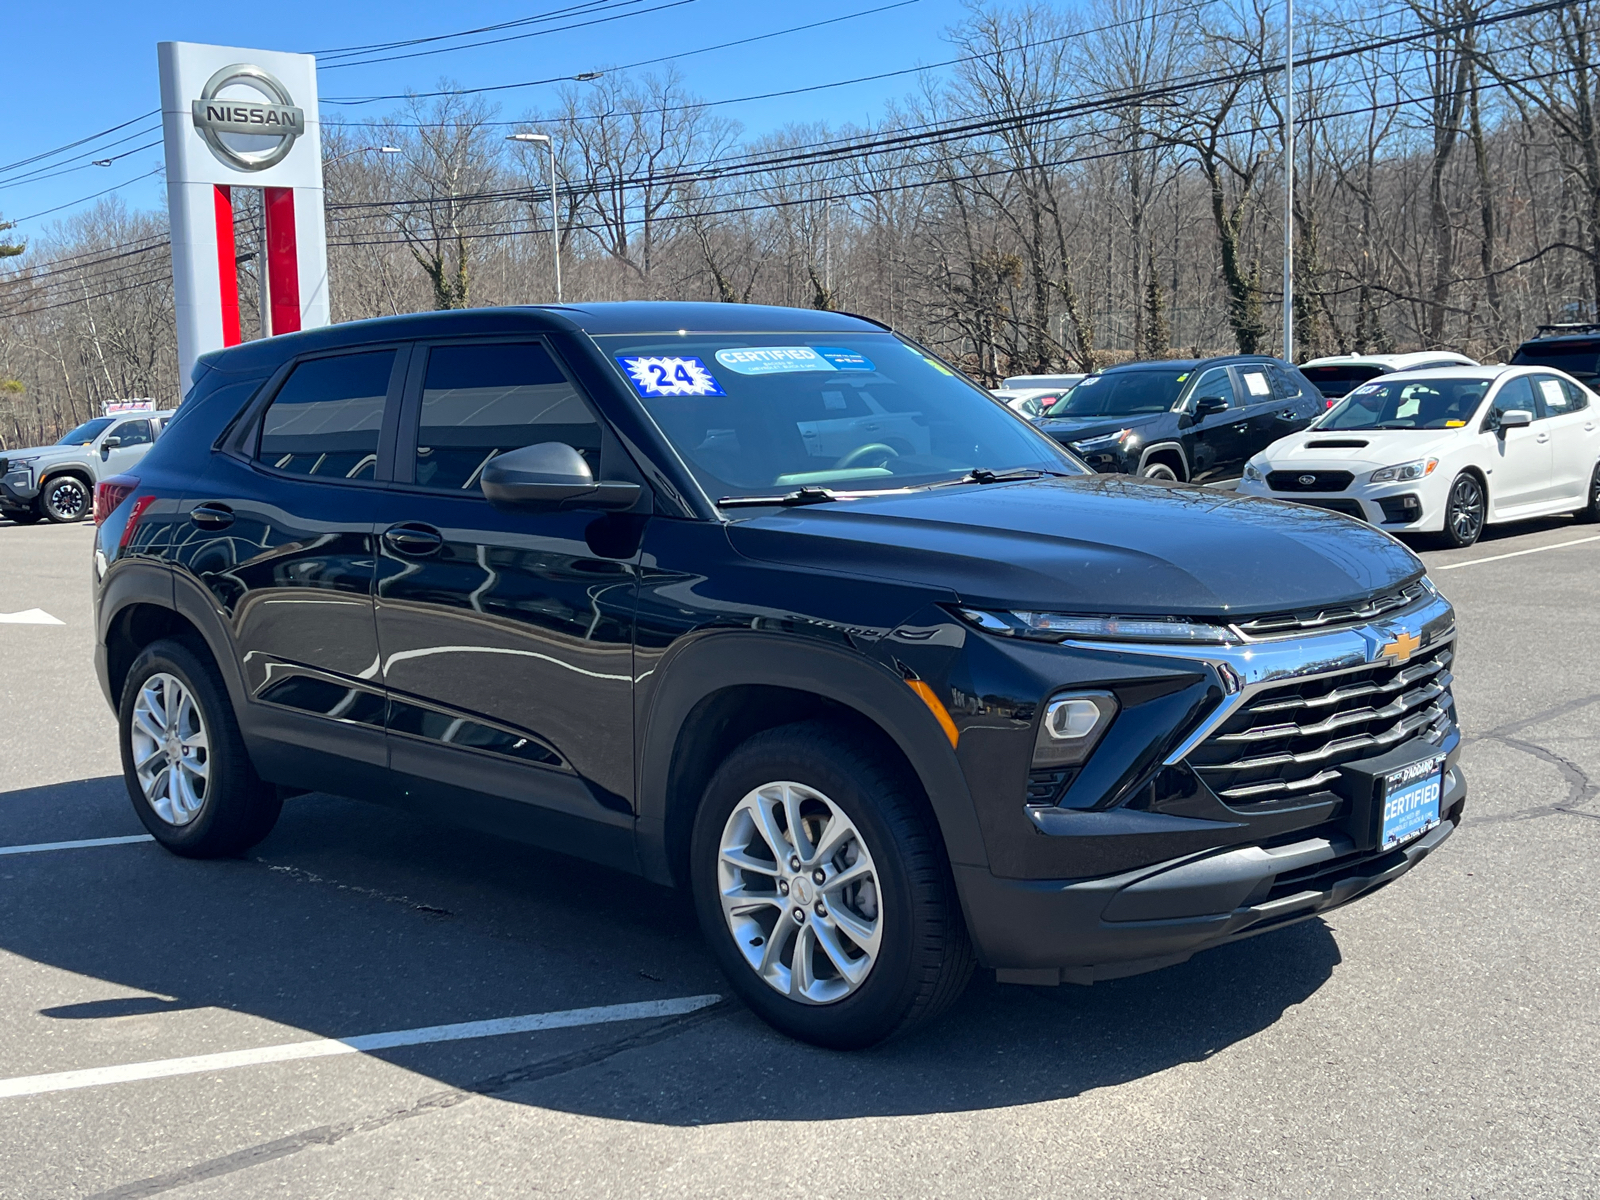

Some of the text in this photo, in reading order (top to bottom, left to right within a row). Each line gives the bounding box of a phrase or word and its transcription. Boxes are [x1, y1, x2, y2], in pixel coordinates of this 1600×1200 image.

[206, 105, 296, 127] NISSAN
[720, 349, 816, 364] CERTIFIED
[648, 363, 695, 387] 24
[1384, 783, 1440, 821] CERTIFIED
